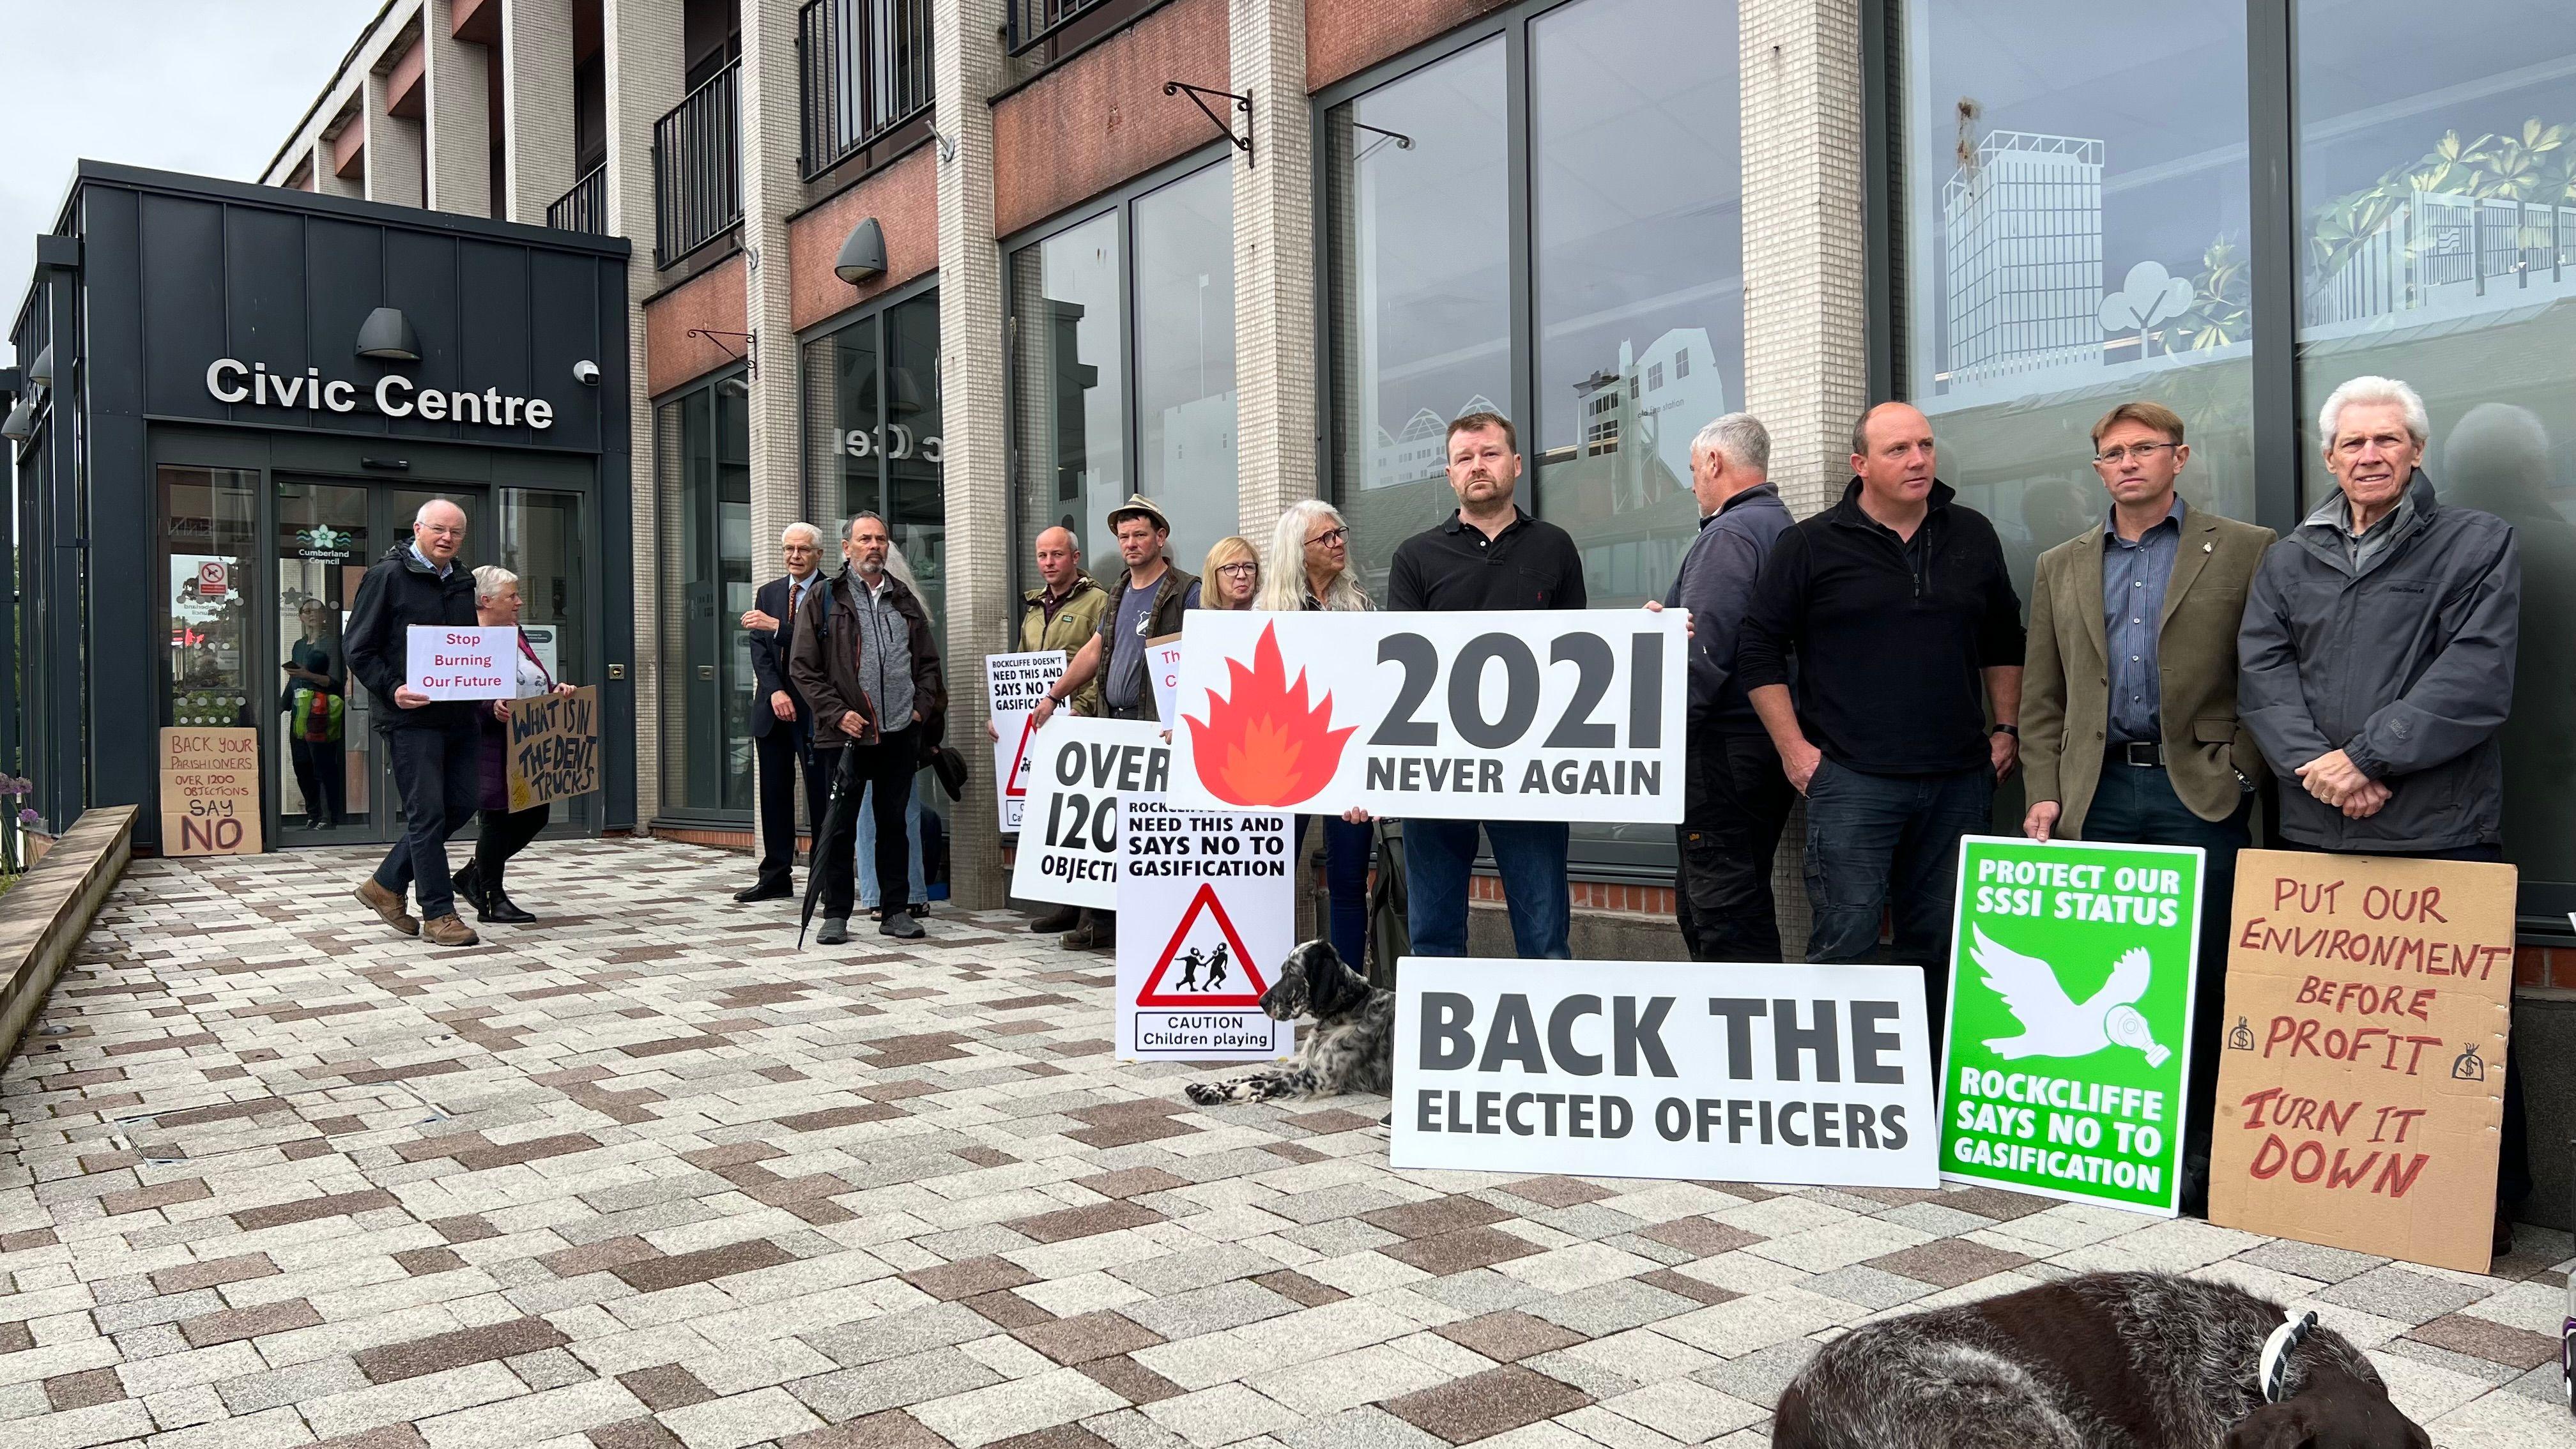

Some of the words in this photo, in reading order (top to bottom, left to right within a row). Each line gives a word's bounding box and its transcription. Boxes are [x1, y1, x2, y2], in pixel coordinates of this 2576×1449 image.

[206, 358, 356, 412] Civic
[374, 374, 554, 429] Centre
[1662, 398, 1685, 411] station
[299, 549, 349, 558] Cumberland
[447, 633, 480, 647] Stop
[435, 654, 492, 668] Burning
[992, 659, 1030, 668] ROCKCLIFFE
[1032, 657, 1062, 666] DOESN'T
[1162, 650, 1181, 664] Th
[422, 676, 450, 687] Our
[455, 675, 502, 686] Future
[993, 670, 1016, 680] NEED
[1019, 669, 1039, 679] THIS
[1043, 668, 1062, 677] AND
[995, 682, 1021, 696] SAYS
[1025, 682, 1043, 695] NO
[1165, 675, 1177, 687] C
[996, 696, 1066, 710] GASIFICAN
[1367, 632, 1664, 749] 2021
[512, 699, 559, 745] WHAT
[564, 699, 576, 733] IS
[577, 699, 591, 735] IN
[172, 736, 213, 753] BACK
[218, 737, 254, 753] YOUR
[519, 737, 552, 778] THE
[553, 735, 597, 773] DENT
[171, 756, 252, 770] PARISHIONERS
[1055, 741, 1170, 792] OVER
[1366, 757, 1504, 793] NEVER
[1519, 759, 1661, 795] AGAIN
[175, 775, 203, 785] OVER
[208, 774, 234, 783] 1200
[184, 786, 249, 796] OBJECTIONS
[532, 767, 594, 801] TRUCKS
[190, 799, 233, 817] SAY
[1045, 792, 1117, 853] 120
[181, 815, 243, 851] NO
[1130, 817, 1182, 831] NEED
[1190, 817, 1233, 831] THIS
[1240, 817, 1284, 831] AND
[1129, 836, 1190, 855] SAYS
[1202, 836, 1240, 855] NO
[1250, 836, 1284, 855] TO
[1041, 855, 1117, 884] OBJECTI
[1129, 860, 1285, 876] GASIFICATION
[1977, 859, 2106, 890] PROTECT
[2113, 866, 2180, 894] OUR
[1975, 885, 2043, 917] SSSI
[2054, 891, 2178, 928] STATUS
[2274, 877, 2345, 915] PUT
[2363, 885, 2448, 923] OUR
[2239, 916, 2512, 981] ENVIRONMENT
[2296, 976, 2436, 1021] BEFORE
[1168, 1016, 1243, 1029] CAUTION
[1418, 991, 1678, 1077] BACK
[1708, 997, 1905, 1085] THE
[1144, 1033, 1208, 1045] Children
[1214, 1033, 1268, 1046] playing
[2264, 1016, 2444, 1076] PROFIT
[1959, 1066, 2163, 1121] ROCKCLIFFE
[1416, 1089, 1634, 1138] ELECTED
[1655, 1096, 1908, 1151] OFFICERS
[1956, 1101, 2035, 1139] SAYS
[2048, 1113, 2101, 1149] NO
[2113, 1122, 2161, 1158] TO
[2241, 1087, 2363, 1137] TURN
[2367, 1106, 2427, 1144] IT
[1953, 1137, 2160, 1193] GASIFICATION
[2250, 1133, 2430, 1199] DOWN
